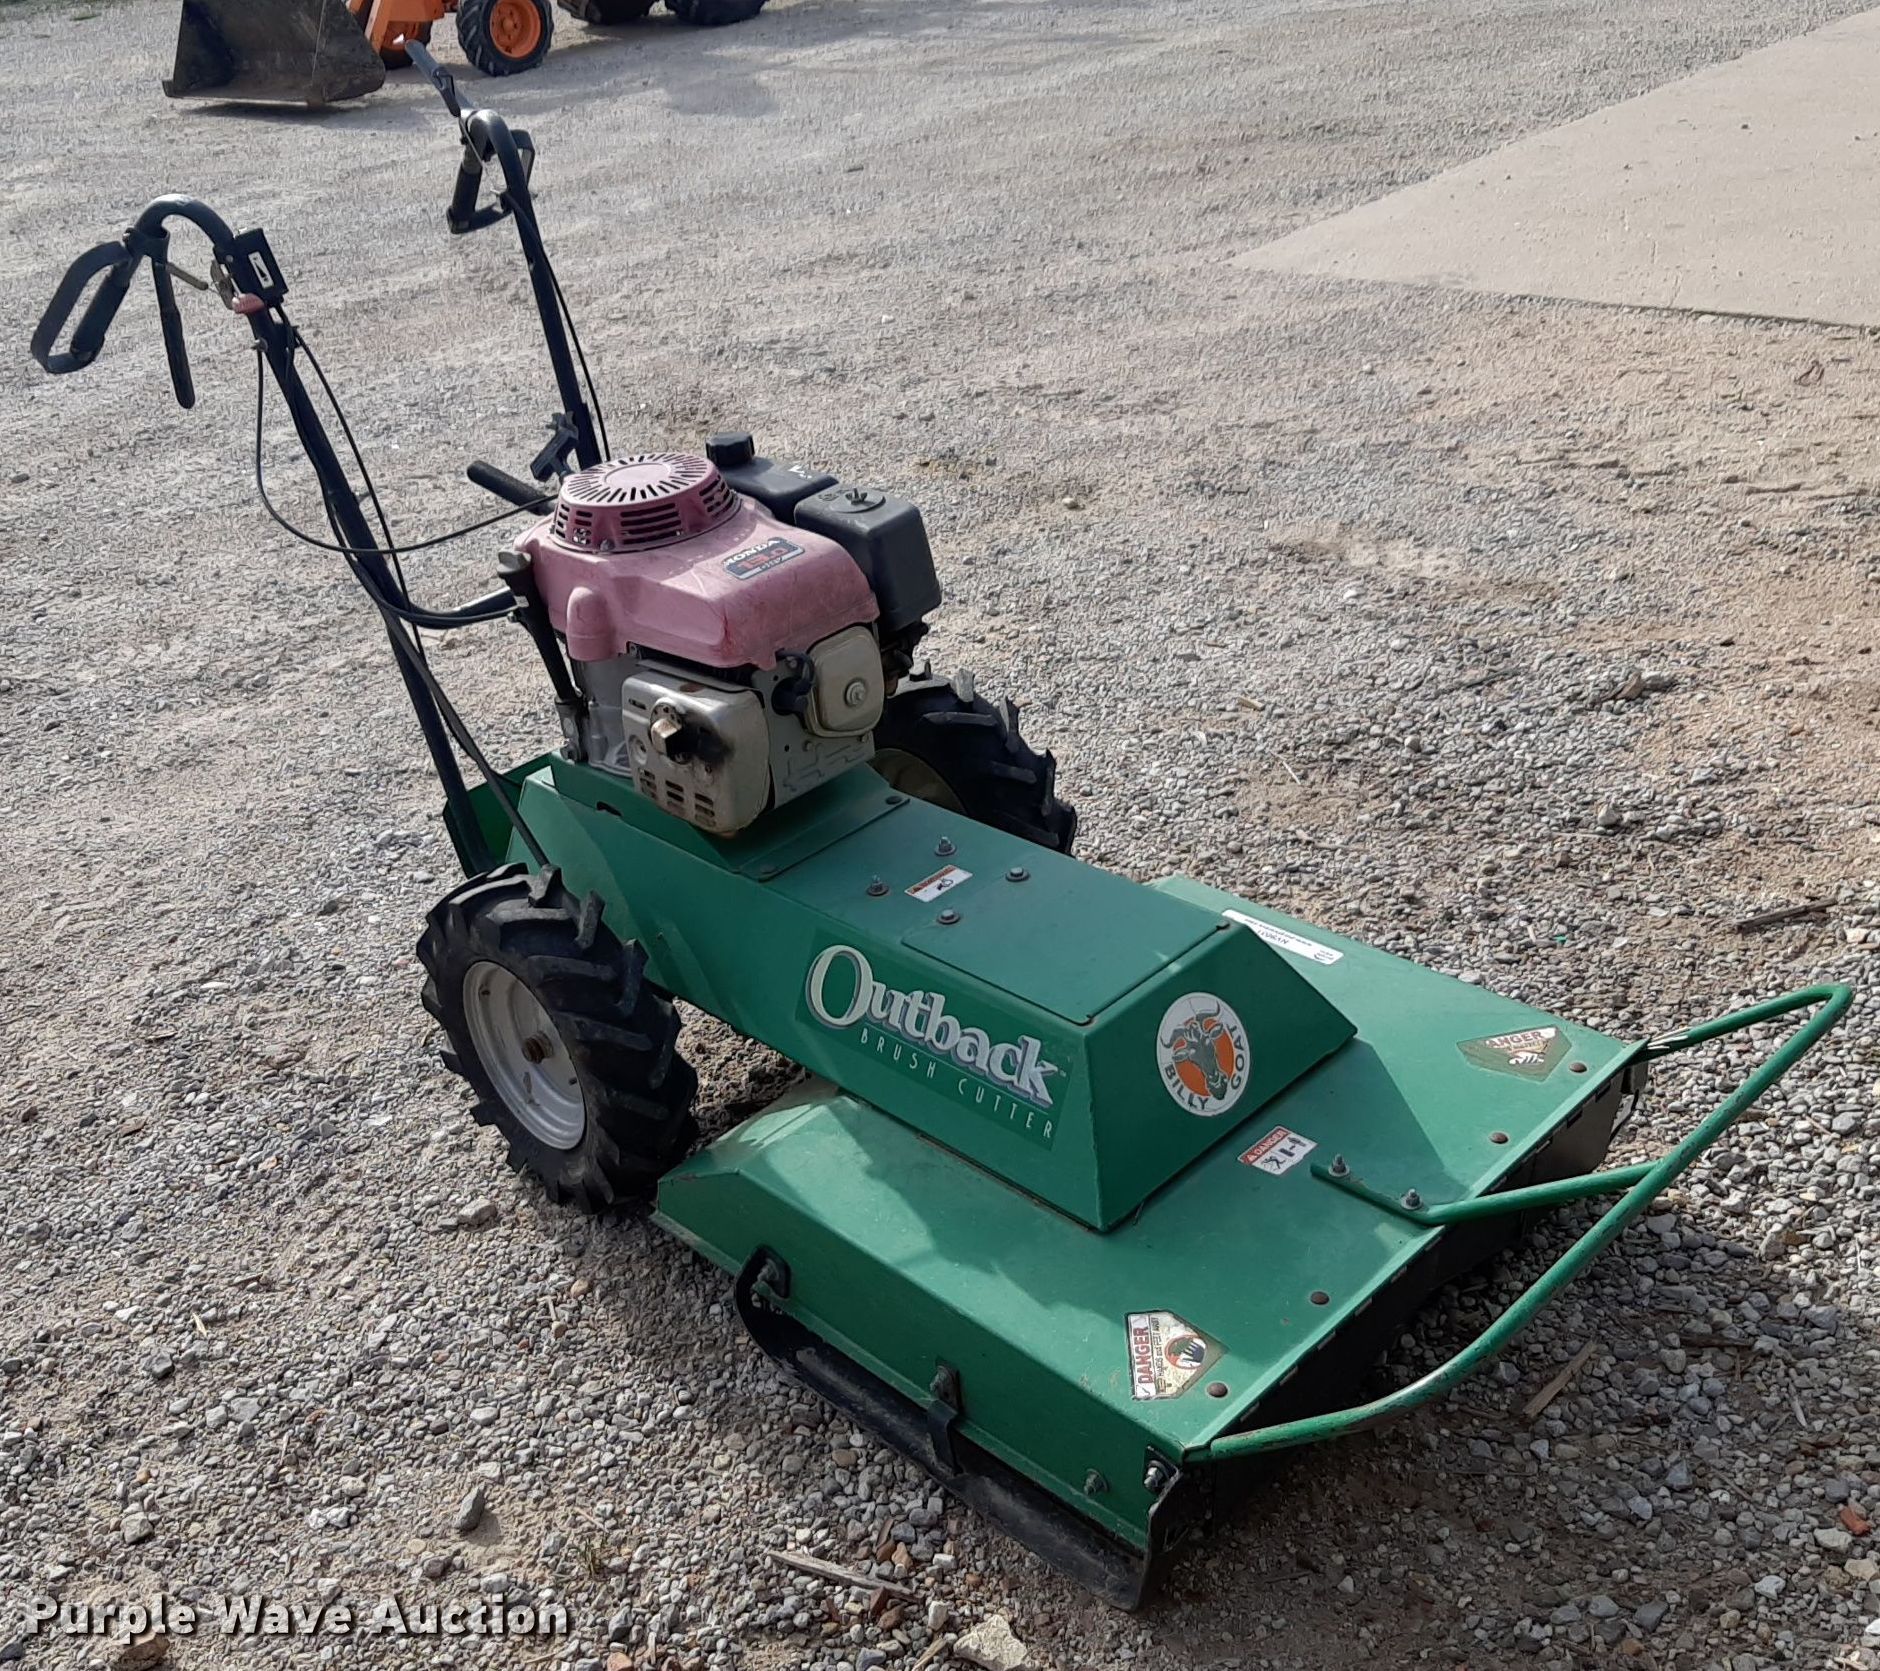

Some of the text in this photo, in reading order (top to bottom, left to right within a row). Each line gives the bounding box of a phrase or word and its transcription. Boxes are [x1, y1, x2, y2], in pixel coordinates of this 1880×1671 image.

[723, 539, 780, 566] HONDA
[805, 944, 1054, 1108] Outback
[1485, 1031, 1543, 1048] ANGER
[860, 1027, 1053, 1139] BRUSH CUTTER
[1164, 1023, 1245, 1110] BILLY GOAT
[1255, 1129, 1288, 1156] DANGER
[1133, 1327, 1154, 1384] DANGER
